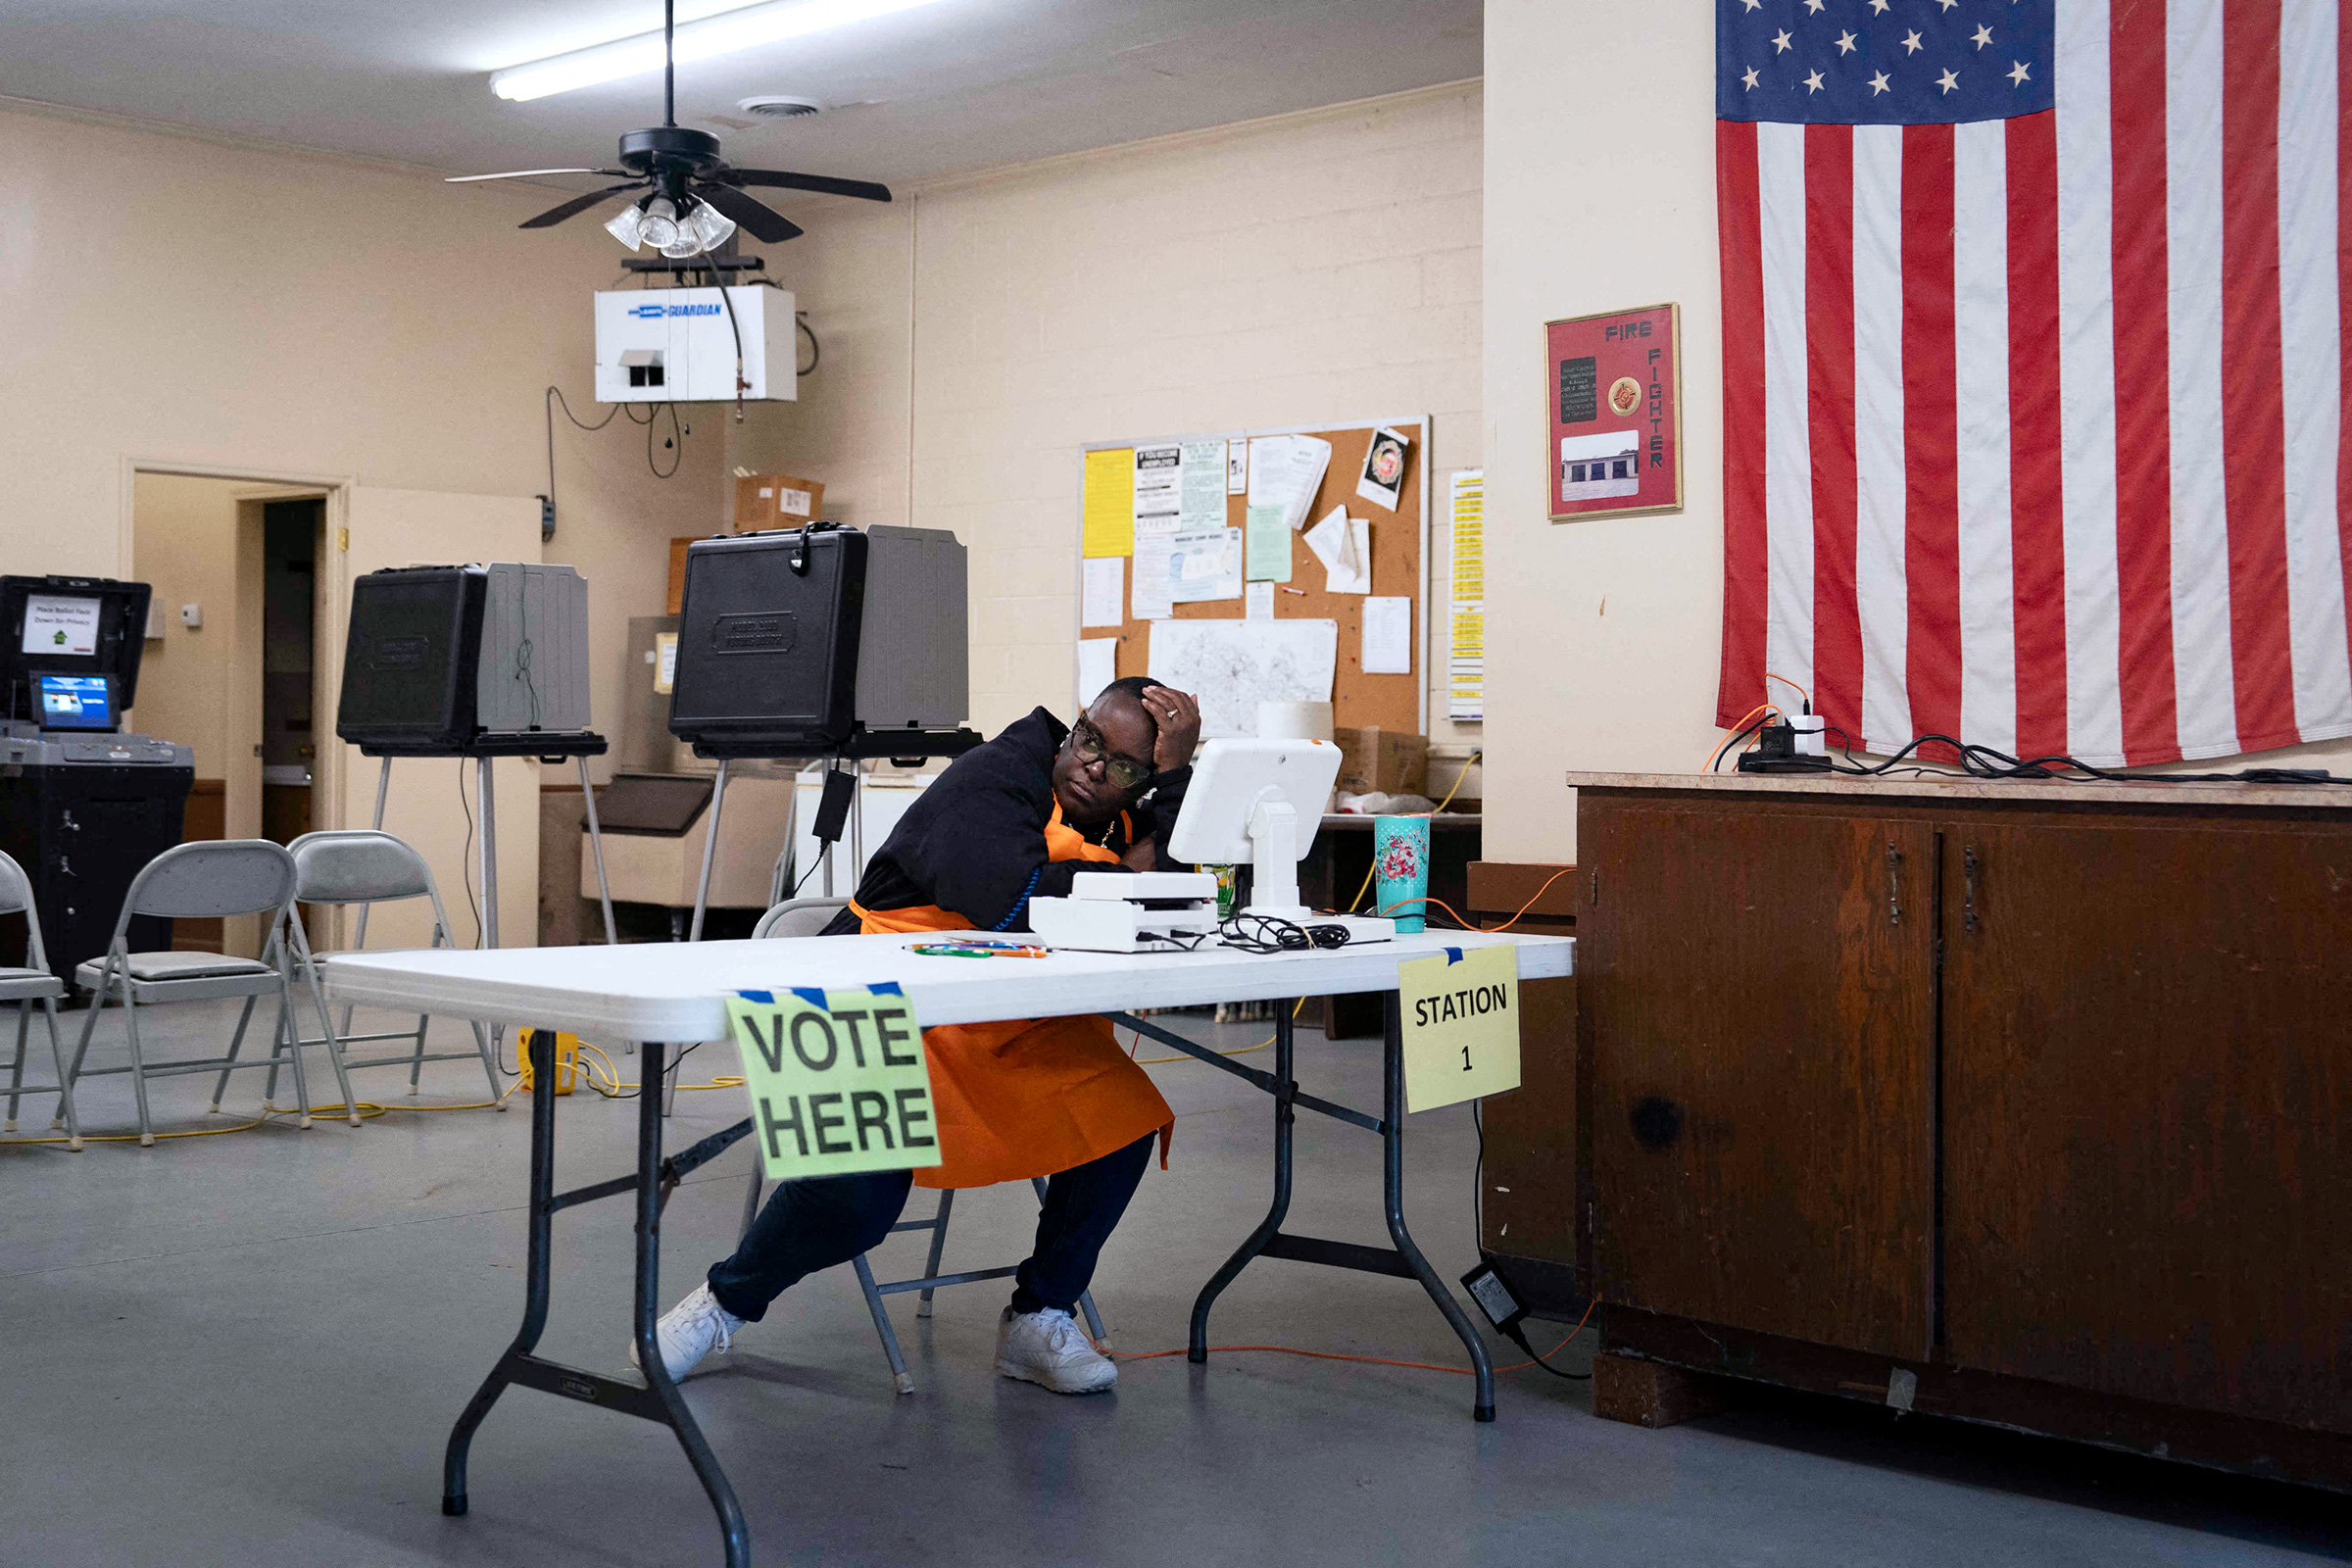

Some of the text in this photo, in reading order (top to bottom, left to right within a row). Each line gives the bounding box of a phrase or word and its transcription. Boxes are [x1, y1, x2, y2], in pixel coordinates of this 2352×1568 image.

[668, 304, 721, 317] GUARDIAN
[1605, 320, 1652, 342] FIRE
[1647, 348, 1663, 468] FIGHTER
[1415, 983, 1507, 1027] STATION
[742, 1007, 917, 1073] VOTE
[1461, 1045, 1473, 1071] 1
[759, 1088, 935, 1158] HERE
